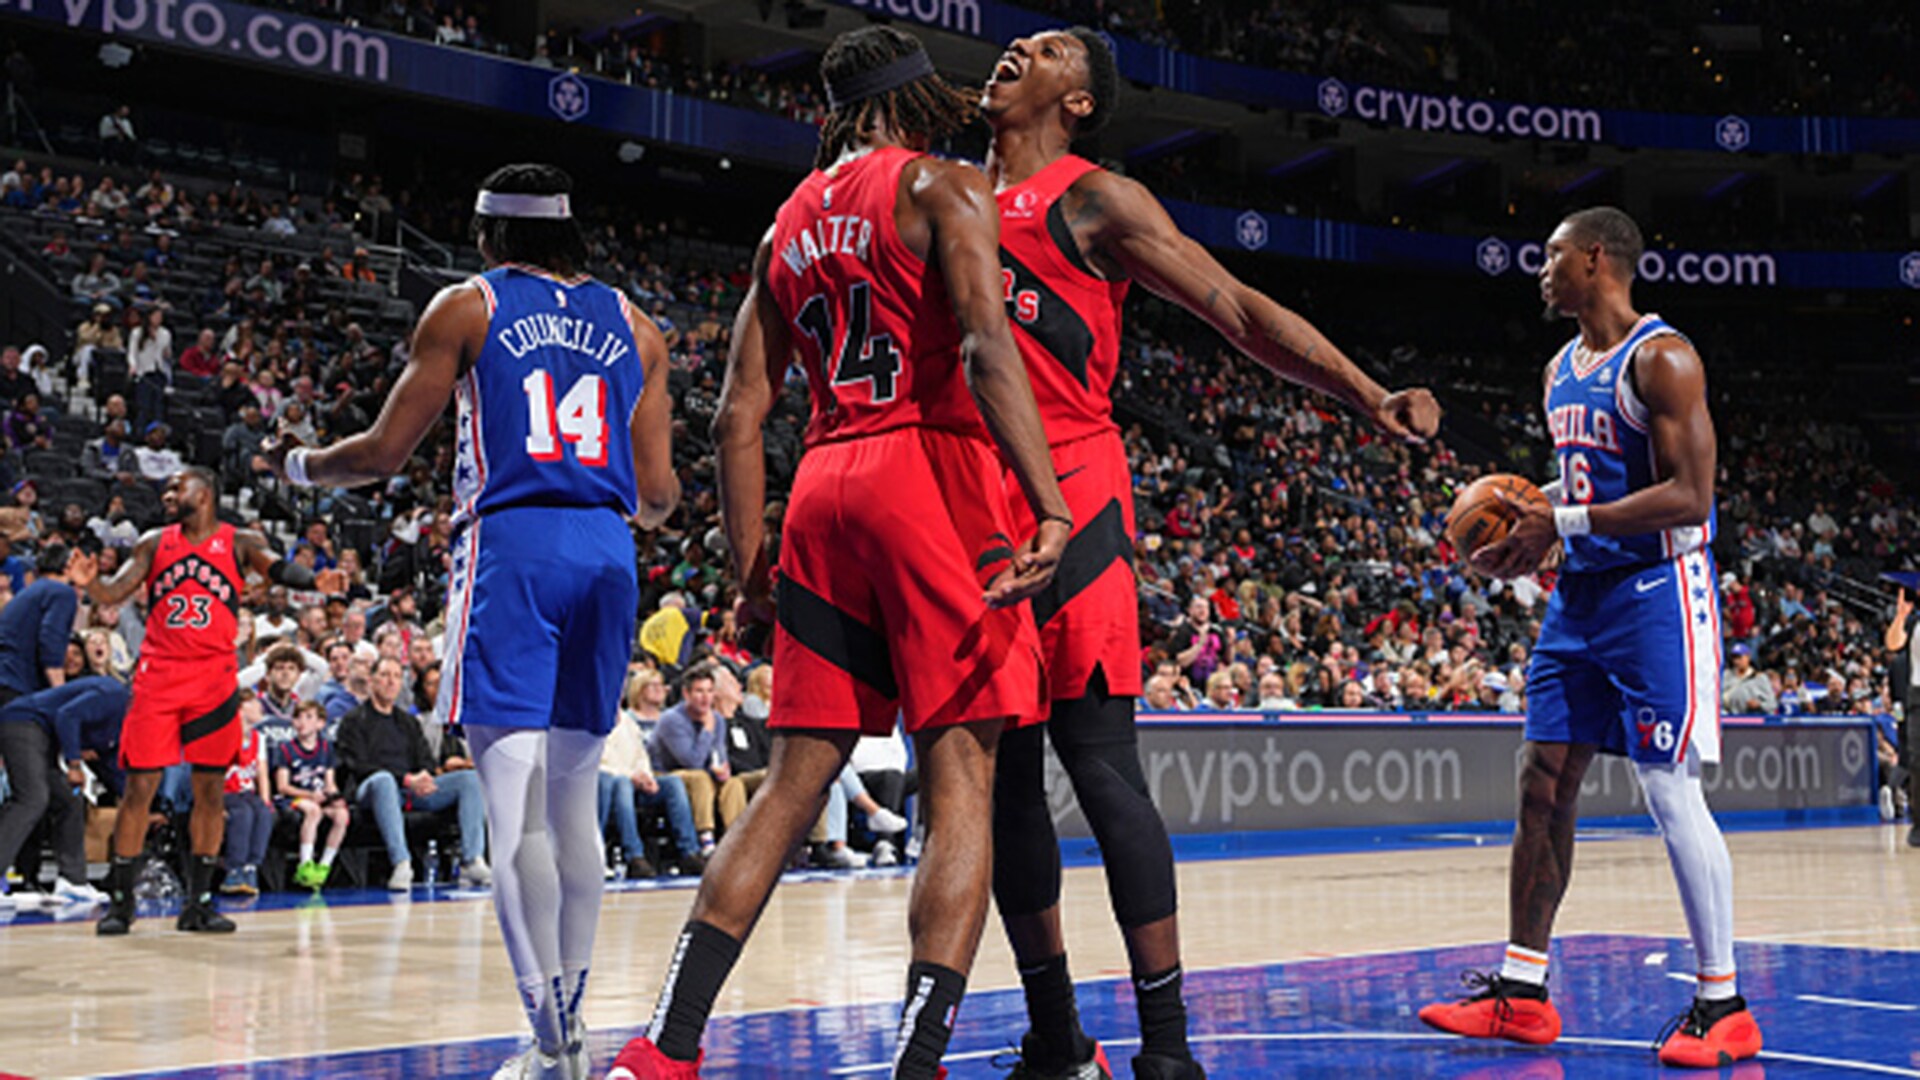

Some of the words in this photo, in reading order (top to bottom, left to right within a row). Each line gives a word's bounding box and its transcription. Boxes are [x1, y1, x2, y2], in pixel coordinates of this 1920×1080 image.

[0, 0, 390, 81] ypto.com
[1354, 87, 1601, 141] crypto.com
[780, 215, 872, 277] WALTER
[1517, 243, 1776, 285] co.com
[498, 313, 595, 359] COUNCIL
[595, 332, 629, 367] IV
[794, 281, 903, 404] 14
[523, 368, 610, 468] 14
[1549, 403, 1623, 455] HILA
[166, 594, 212, 629] 23
[1637, 720, 1675, 751] 76
[1148, 737, 1462, 824] rypto.com
